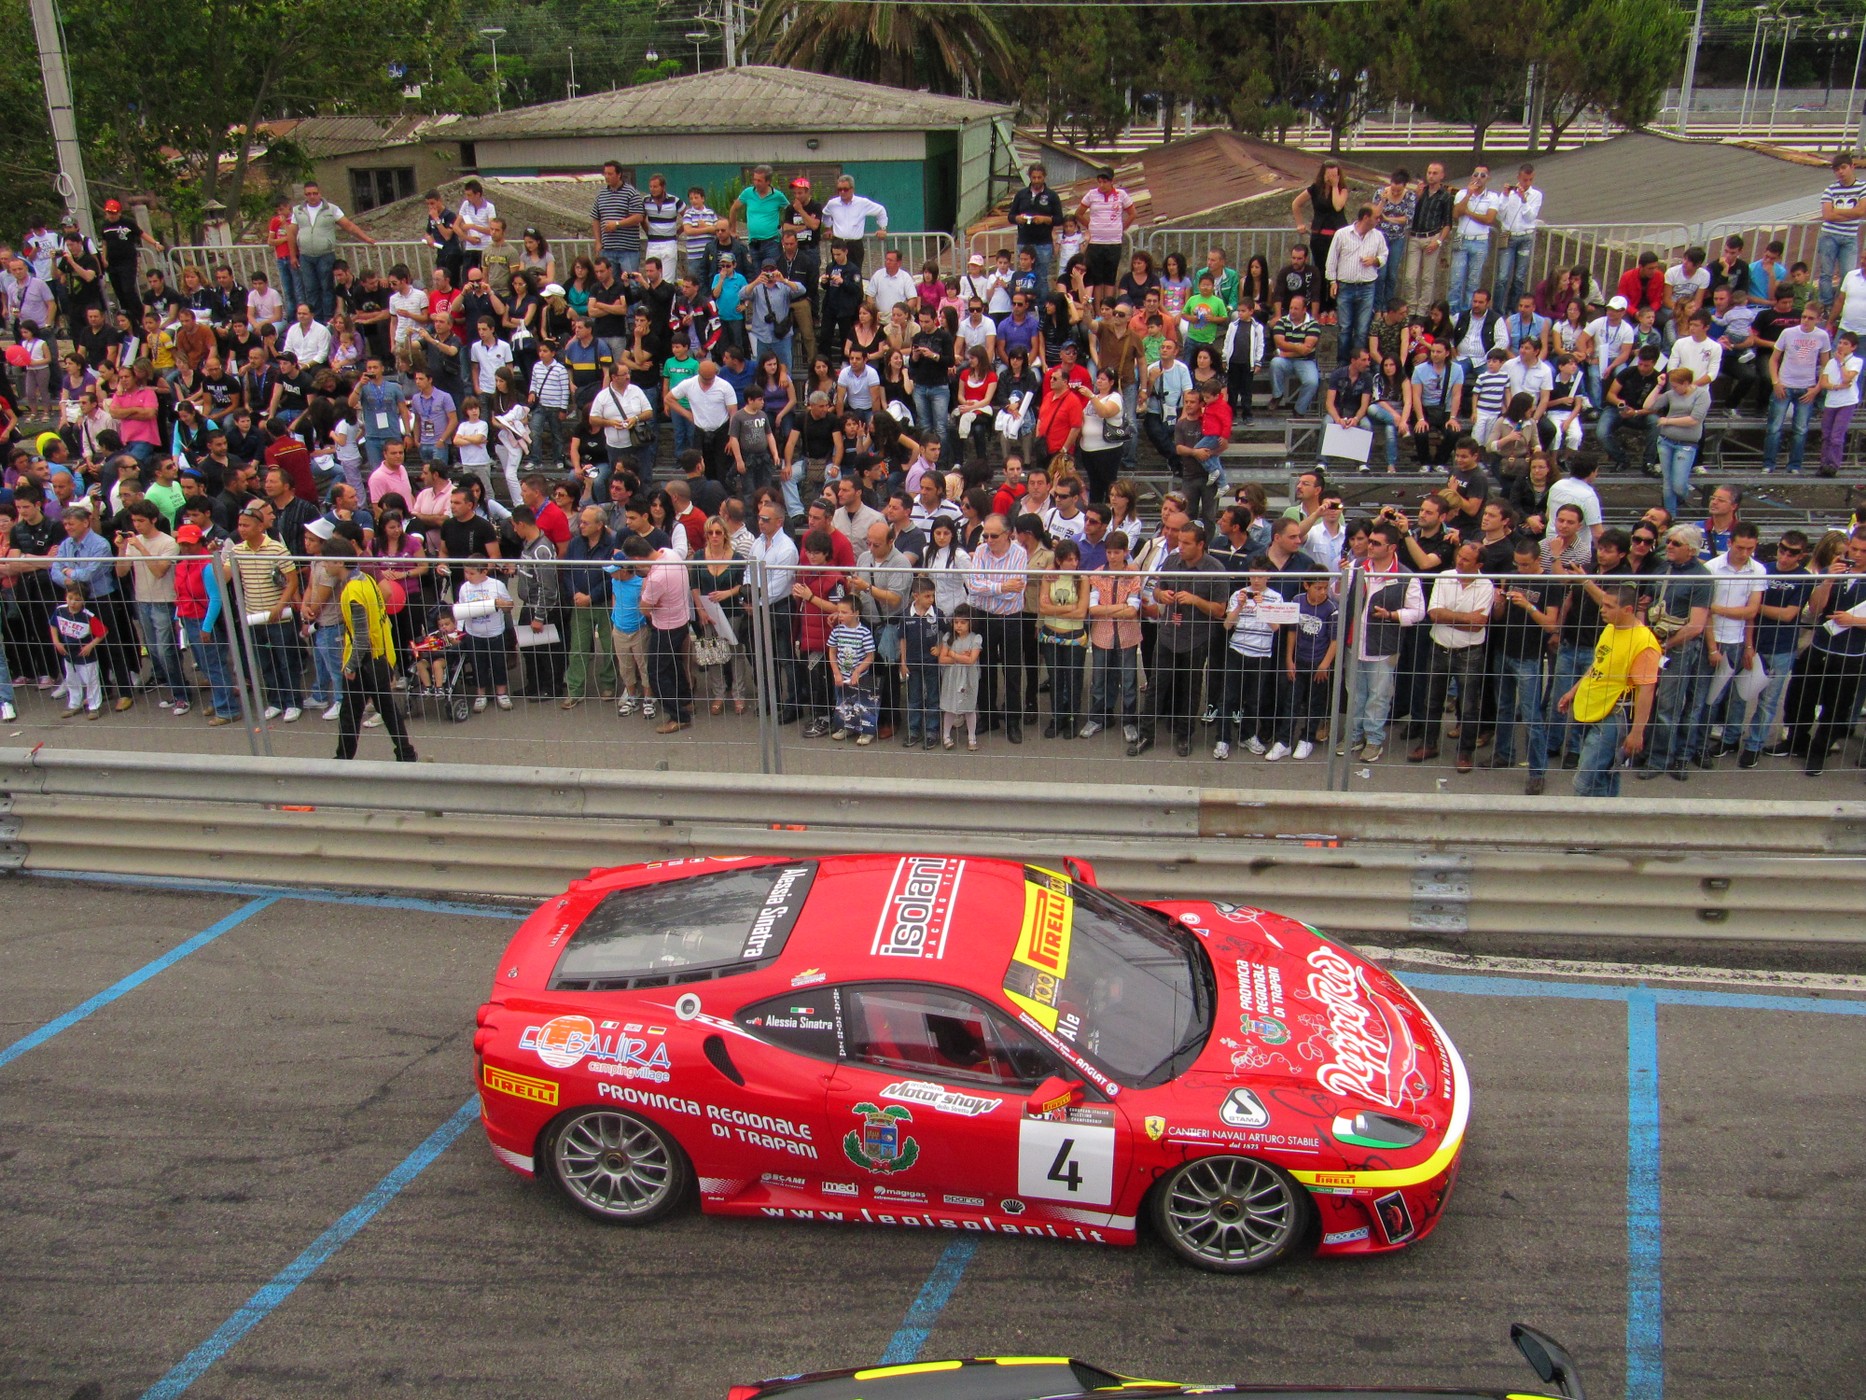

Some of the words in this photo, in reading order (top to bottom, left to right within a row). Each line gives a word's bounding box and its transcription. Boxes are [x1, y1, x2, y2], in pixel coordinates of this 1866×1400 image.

[765, 868, 808, 905] Alessia
[880, 857, 947, 957] isolani
[925, 898, 947, 959] RACING
[943, 859, 958, 885] TEAM
[743, 905, 788, 958] Sinatra
[1028, 888, 1065, 970] PIRELLI
[1035, 972, 1055, 1004] 100
[1236, 960, 1253, 1011] PROVINCIA
[1252, 962, 1270, 1014] REGIONALE
[1267, 966, 1284, 1005] TRAPANI
[766, 1014, 798, 1028] Alessia
[799, 1016, 833, 1031] Sinatra
[1056, 1013, 1081, 1043] Ale
[486, 1067, 556, 1102] PIRELLI
[587, 1060, 671, 1083] campingvillage
[1076, 1058, 1108, 1085] ANGLAT
[597, 1082, 702, 1117] PROVINCIA
[706, 1103, 813, 1141] REGIONALE
[881, 1083, 942, 1101] Motor
[941, 1093, 1001, 1115] show
[1228, 1115, 1261, 1124] STAMA
[711, 1122, 731, 1140] DI
[734, 1127, 819, 1160] TRAPANI
[1168, 1126, 1210, 1139] CANTIERI
[1212, 1130, 1246, 1141] NAVALI
[1248, 1133, 1285, 1145] ARTURO
[1287, 1135, 1319, 1148] STABILE
[1228, 1141, 1241, 1149] dal
[1046, 1138, 1083, 1192] 4
[1315, 1173, 1356, 1185] PIRELLI
[886, 1187, 926, 1199] magigas
[944, 1194, 984, 1206] sparco
